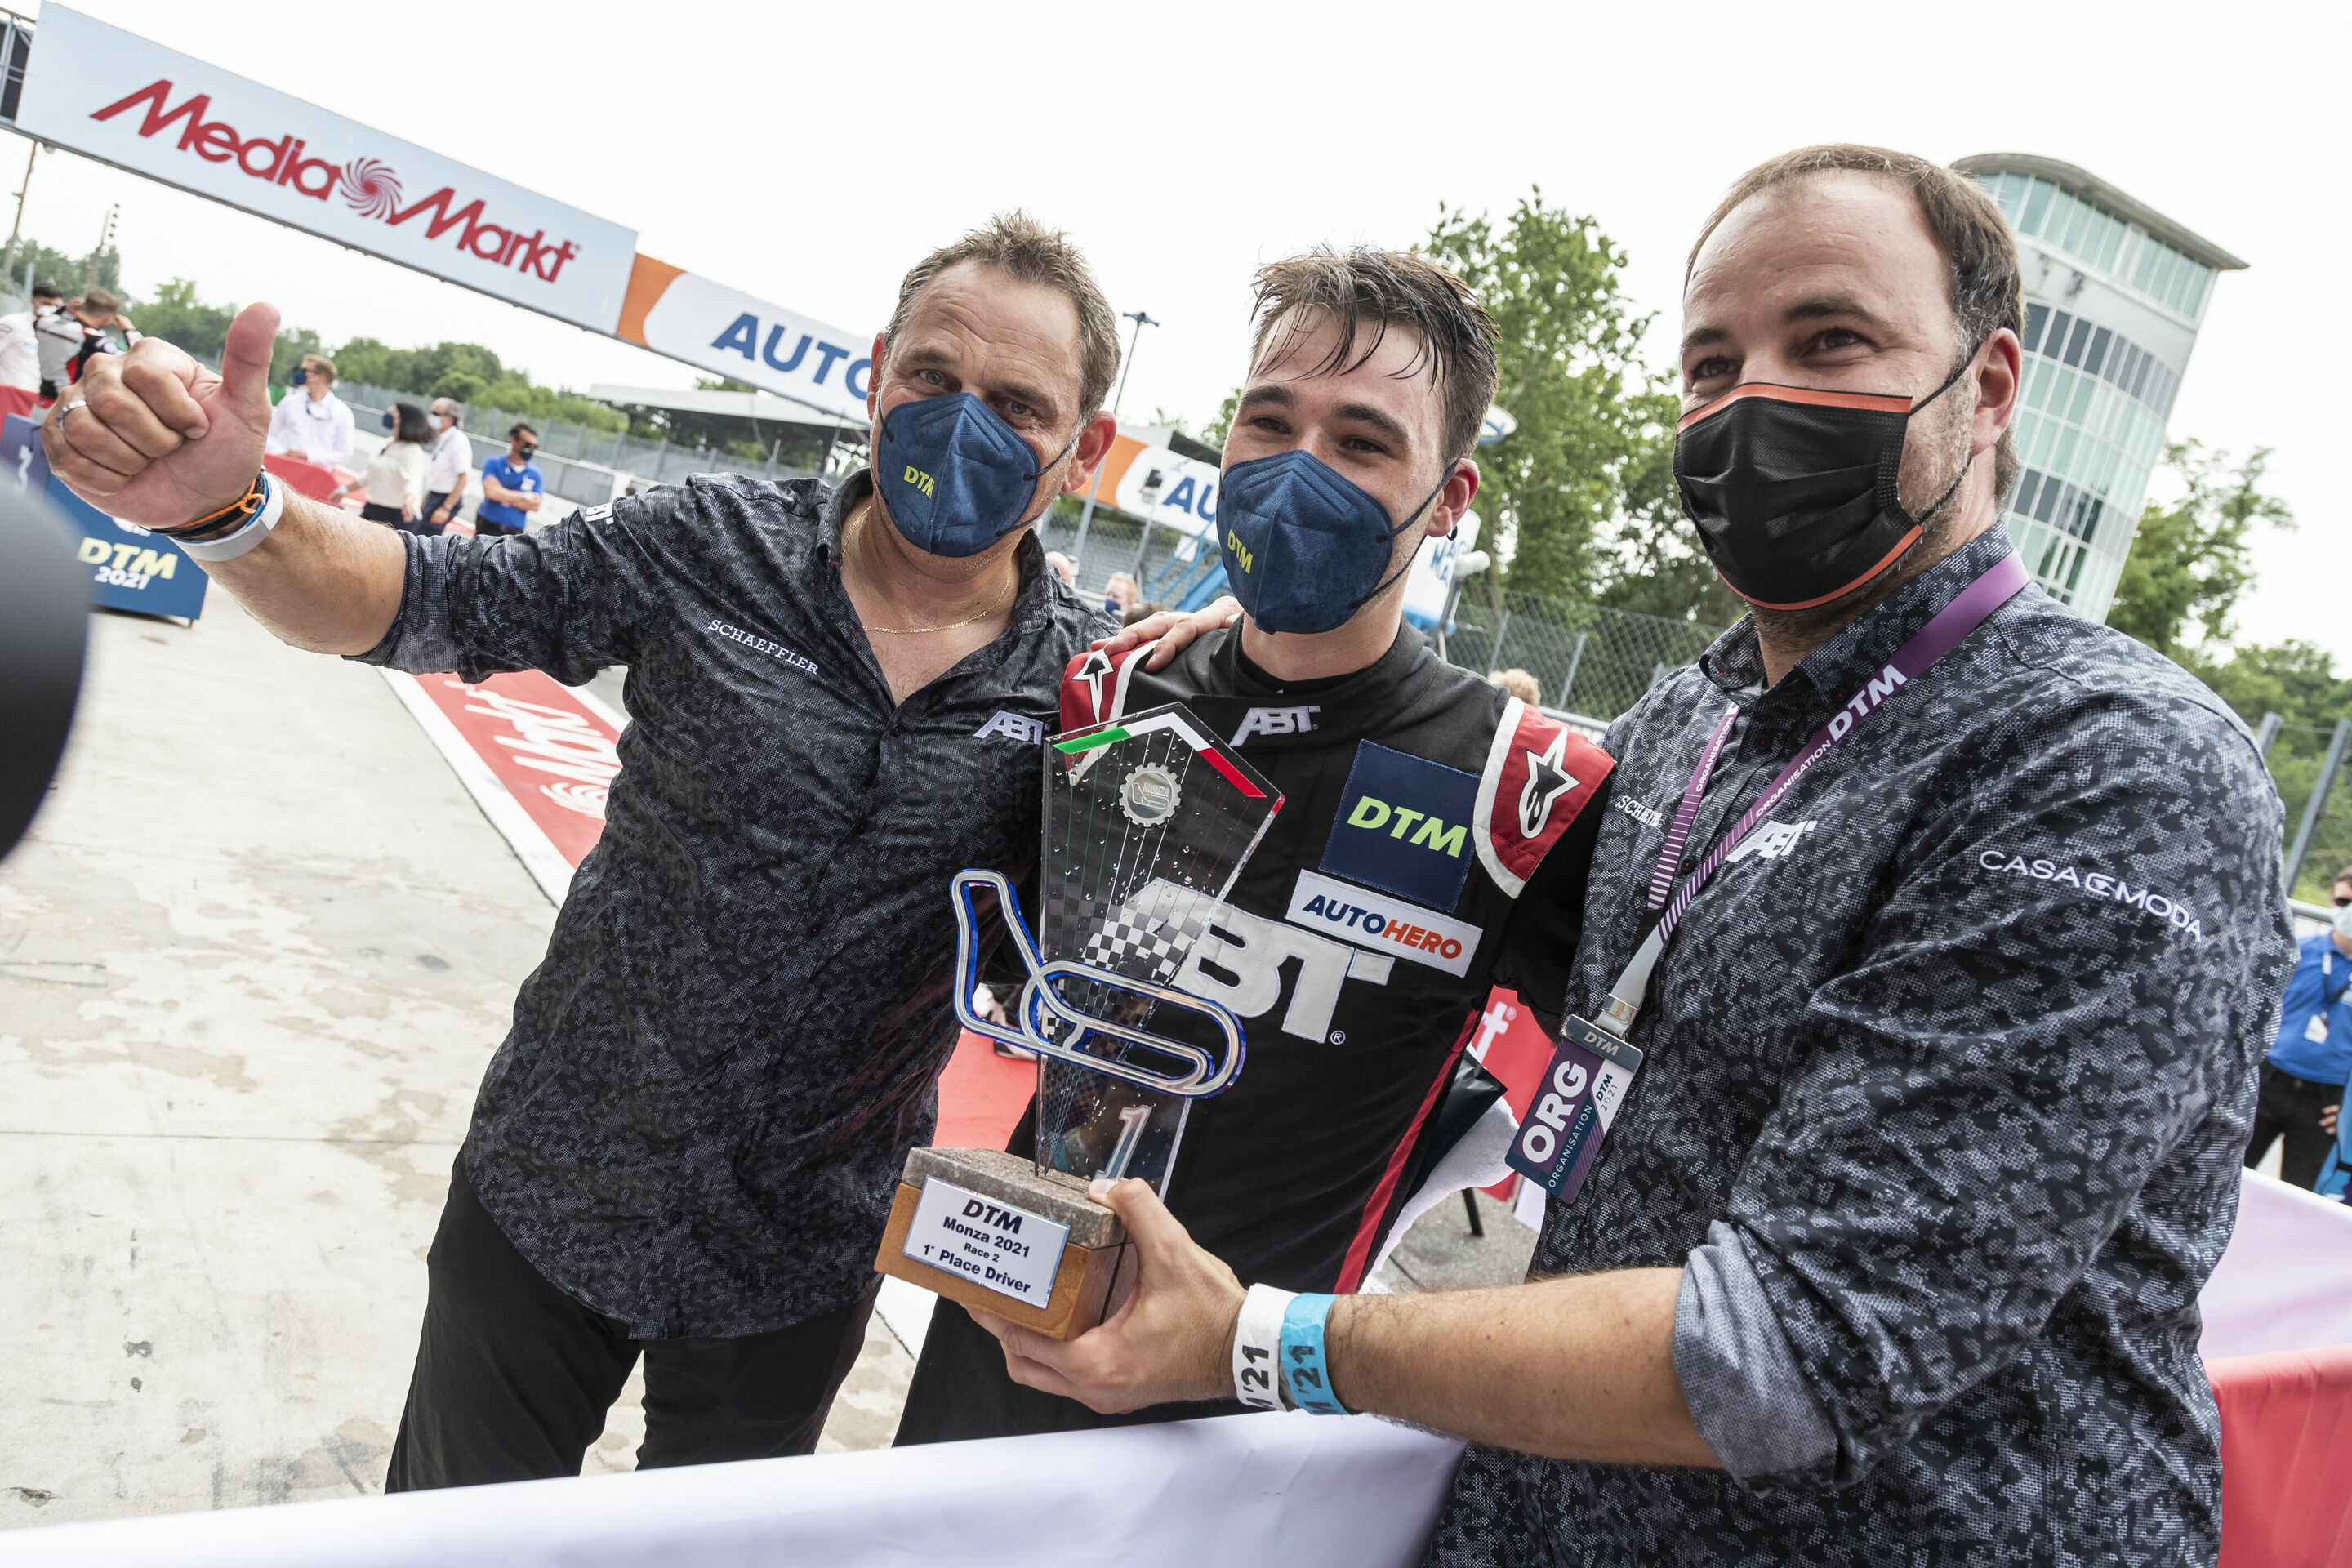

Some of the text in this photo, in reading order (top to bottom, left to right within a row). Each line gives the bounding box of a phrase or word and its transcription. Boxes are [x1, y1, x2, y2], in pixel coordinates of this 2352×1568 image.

[88, 79, 576, 283] Media Markt
[78, 537, 178, 580] DTM
[1227, 528, 1254, 574] DTM
[94, 565, 152, 590] 2021
[707, 619, 819, 675] SCHAEFFLER
[973, 709, 1052, 746] ABT
[1228, 705, 1321, 747] ABT
[1756, 663, 1909, 817] ORGANISATION DTM
[1695, 716, 1735, 792] ORGANISATION
[1347, 795, 1468, 858] DTM
[1724, 819, 1818, 862] ABT
[1302, 894, 1463, 960] AUTOHERO
[1584, 1031, 1619, 1057] DTM
[1596, 1073, 1613, 1102] DTM
[1600, 1084, 1619, 1112] 2021
[1522, 1061, 1588, 1163] ORG
[1548, 1104, 1592, 1188] ORGANISATION
[942, 1216, 1031, 1258] Monza 2021
[962, 1198, 1023, 1235] DTM
[939, 1249, 981, 1275] Place
[984, 1266, 1031, 1294] Driver
[964, 1242, 1000, 1263] Race 2
